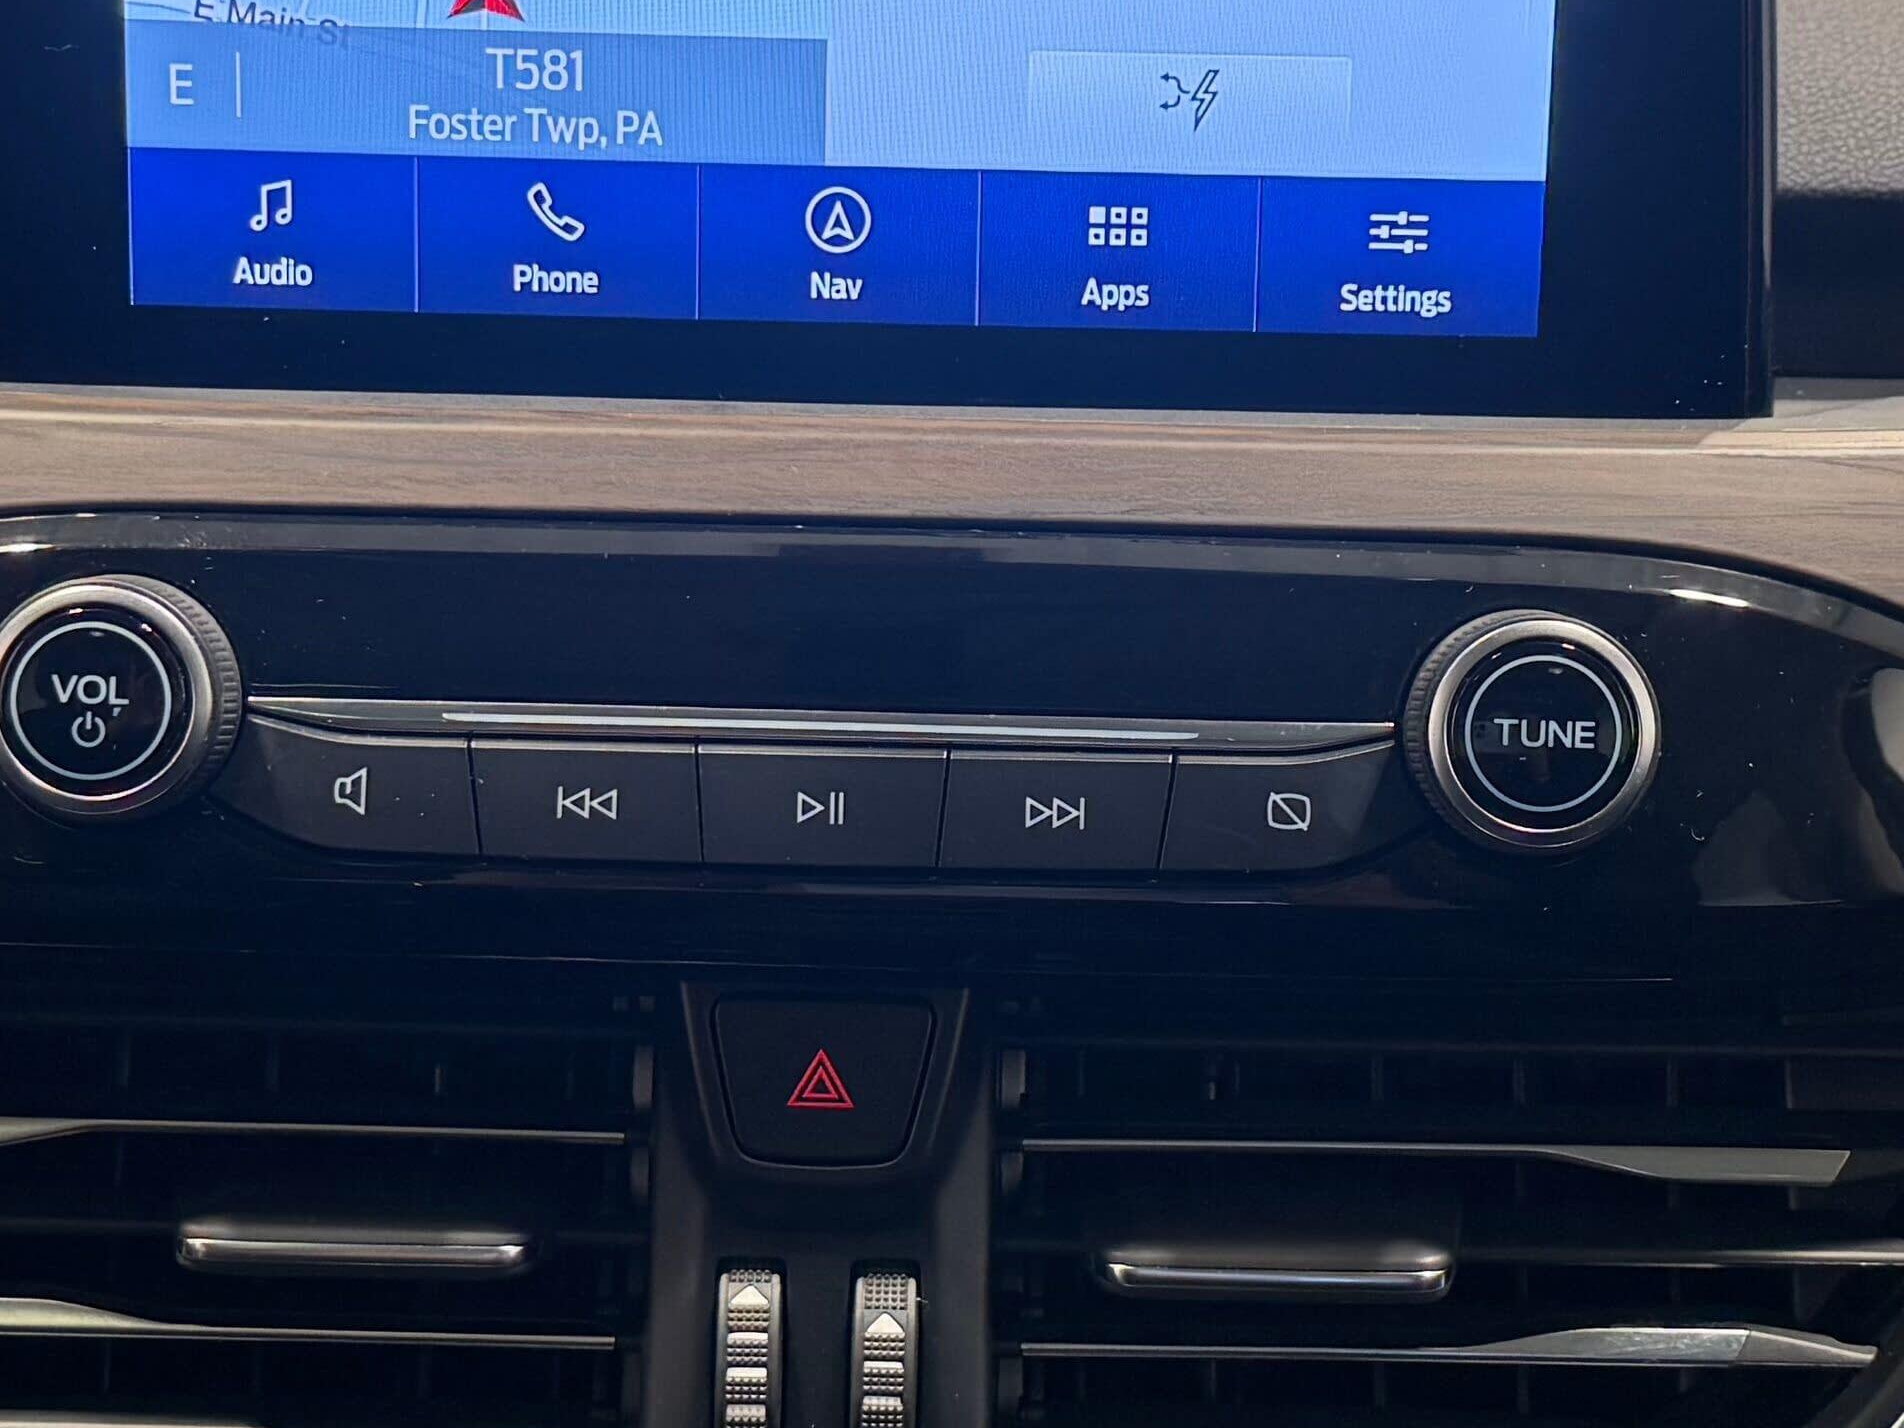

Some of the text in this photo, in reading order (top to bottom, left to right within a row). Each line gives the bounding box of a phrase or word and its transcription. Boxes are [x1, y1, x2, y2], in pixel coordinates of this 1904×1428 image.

[168, 63, 194, 106] E
[486, 48, 585, 93] T581
[408, 104, 664, 149] Foster Twp, PA
[233, 257, 313, 288] Audio
[513, 263, 599, 295] Phone
[810, 271, 863, 301] Nav
[1081, 277, 1150, 310] Apps
[1340, 283, 1452, 317] Settings
[51, 673, 129, 706] VOL
[1492, 717, 1596, 749] TUNE
